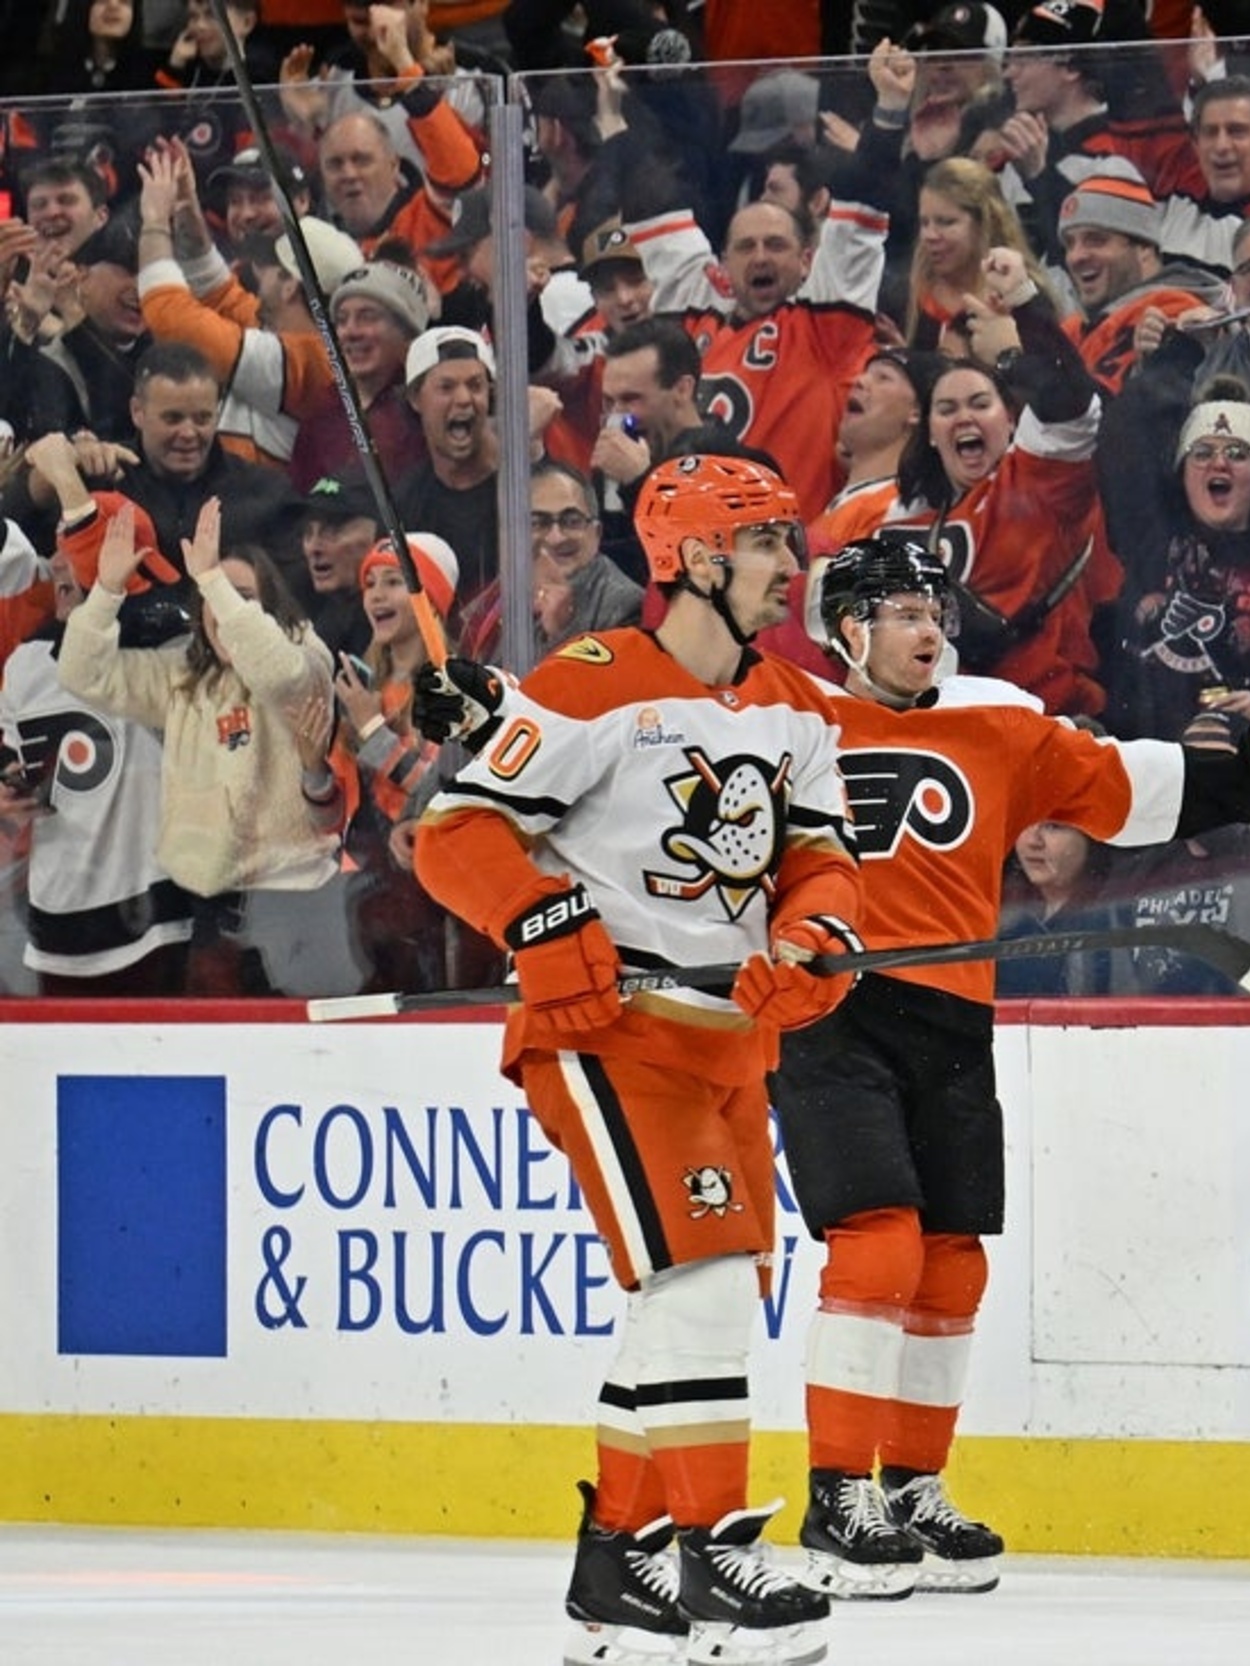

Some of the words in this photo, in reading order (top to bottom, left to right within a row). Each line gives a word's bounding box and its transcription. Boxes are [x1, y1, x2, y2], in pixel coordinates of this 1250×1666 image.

[743, 321, 778, 370] C
[488, 715, 541, 782] 0
[521, 891, 598, 942] BAU
[255, 1104, 584, 1211] CONNE
[256, 1226, 307, 1330] &
[338, 1230, 798, 1339] BUCKE
